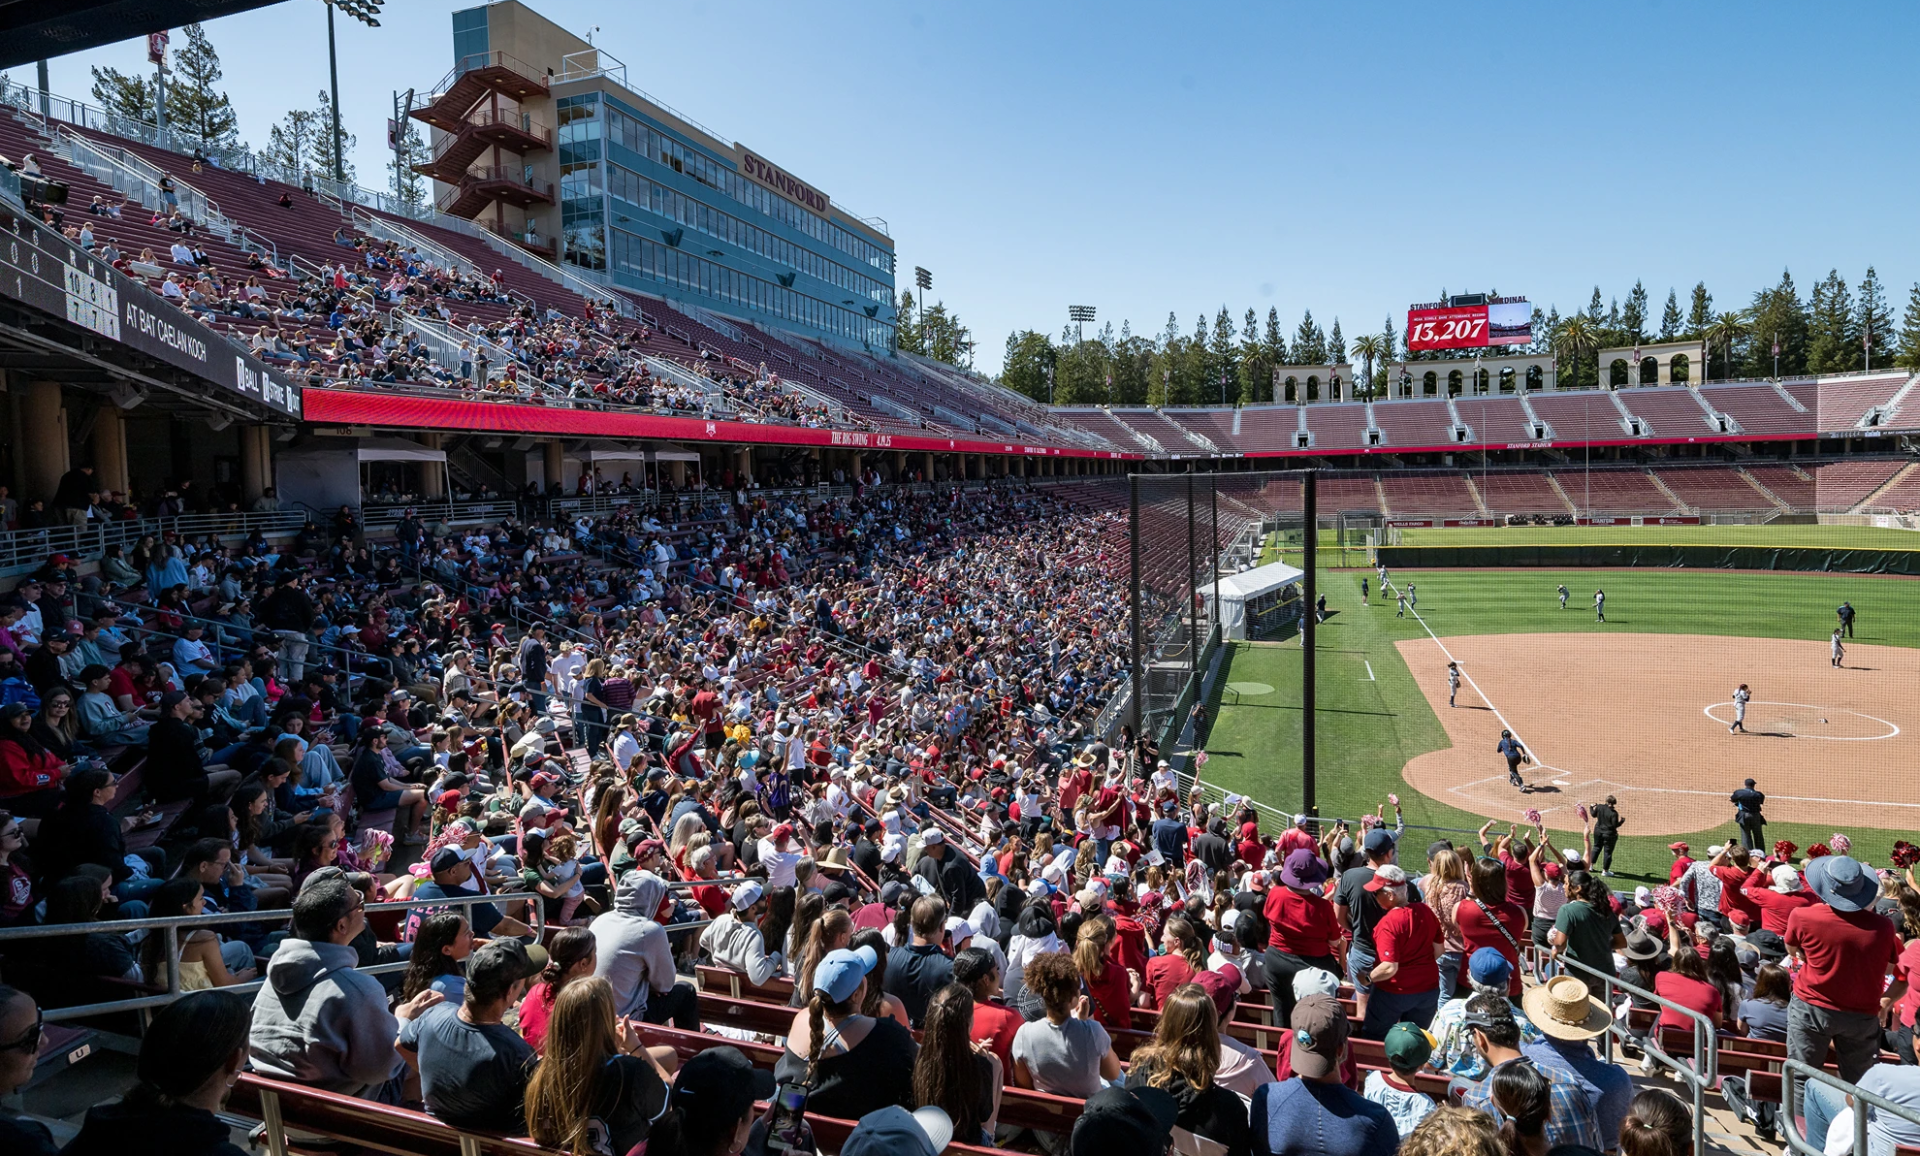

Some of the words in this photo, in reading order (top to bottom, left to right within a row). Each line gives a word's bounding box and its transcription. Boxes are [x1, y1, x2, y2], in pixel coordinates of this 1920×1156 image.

[744, 153, 826, 213] STANFORD
[11, 242, 18, 264] 0
[31, 252, 39, 274] 0
[69, 271, 80, 295] 10
[90, 282, 96, 302] 8
[107, 292, 112, 311] 1
[69, 248, 77, 267] R
[88, 259, 95, 277] H
[105, 270, 111, 286] E
[16, 275, 22, 298] 1
[73, 301, 79, 321] 7
[92, 310, 98, 329] 7
[109, 319, 114, 337] 1
[1410, 301, 1449, 311] STANFORD
[126, 301, 138, 329] AT
[139, 308, 156, 338] BAT
[157, 319, 187, 349] CAELAN
[187, 335, 207, 363] KOCH
[1411, 319, 1487, 343] 13,207
[245, 366, 260, 393] BALL
[269, 380, 284, 405] STRIKE
[831, 431, 842, 444] THE
[76, 1049, 84, 1058] U
